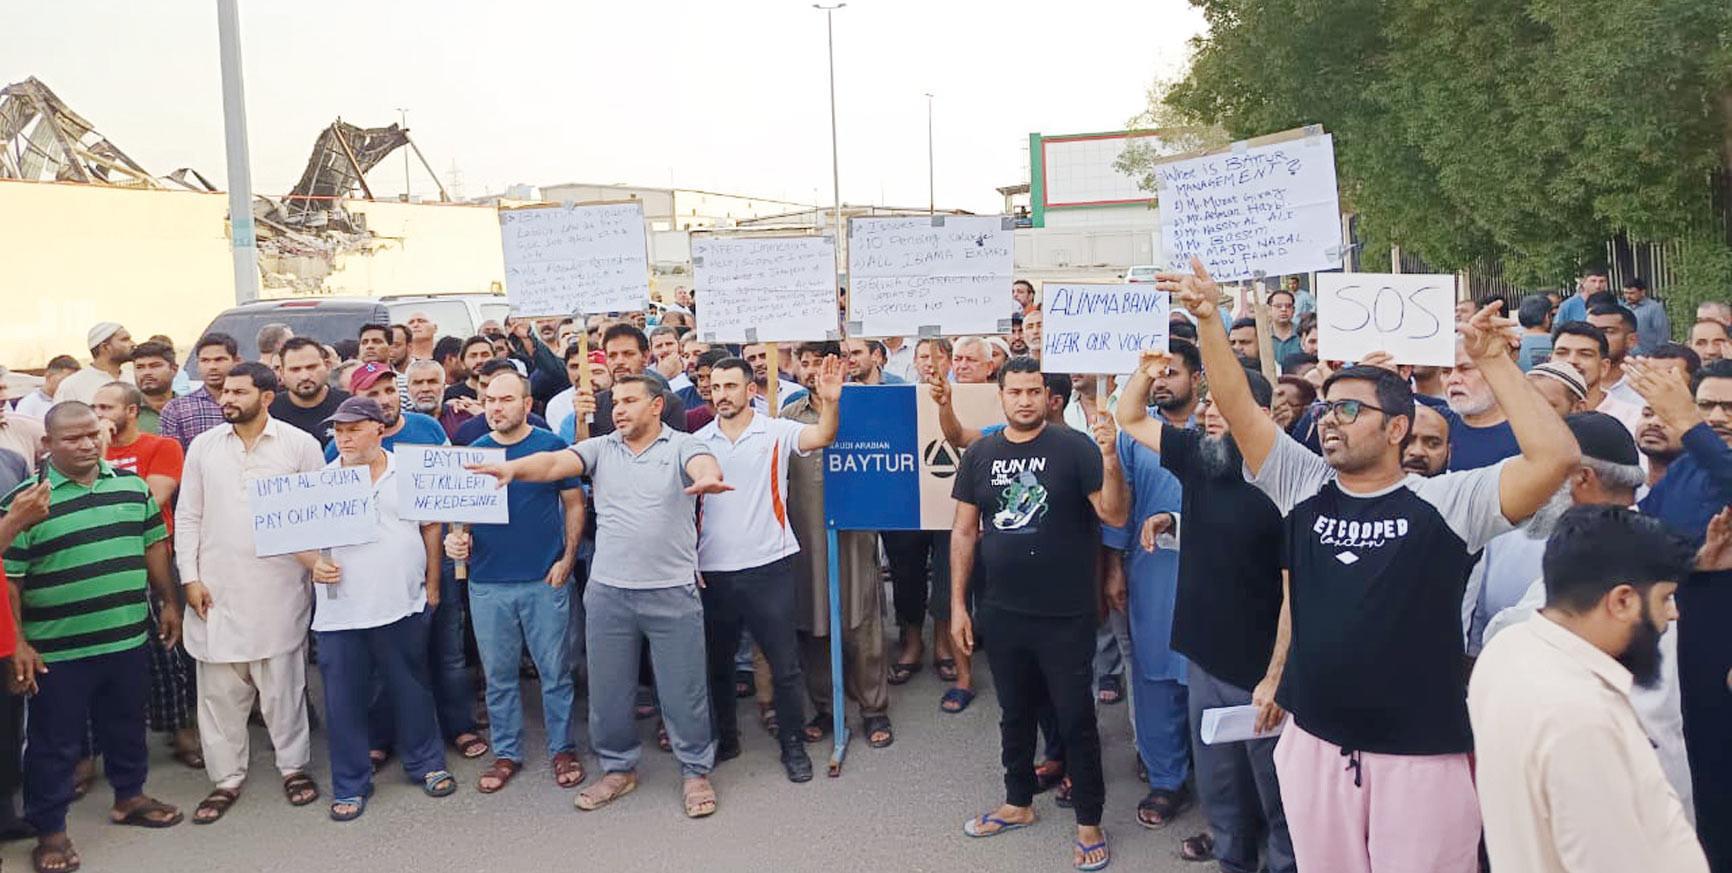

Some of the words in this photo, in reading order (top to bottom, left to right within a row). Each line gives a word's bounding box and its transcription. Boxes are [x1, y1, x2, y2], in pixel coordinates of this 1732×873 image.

[1121, 291, 1162, 313] BANK
[1330, 286, 1441, 340] SOS
[1044, 331, 1080, 355] HEAR
[1086, 331, 1111, 351] OUR
[855, 441, 890, 450] ARABIAN
[829, 453, 914, 472] BAYTUR
[991, 459, 1026, 475] RUN
[1028, 457, 1047, 472] IN
[256, 476, 291, 496] UMM
[298, 474, 316, 488] AL
[320, 469, 361, 487] QURA
[255, 511, 282, 530] PAY
[288, 504, 319, 524] OUR
[324, 497, 369, 518] MONEY
